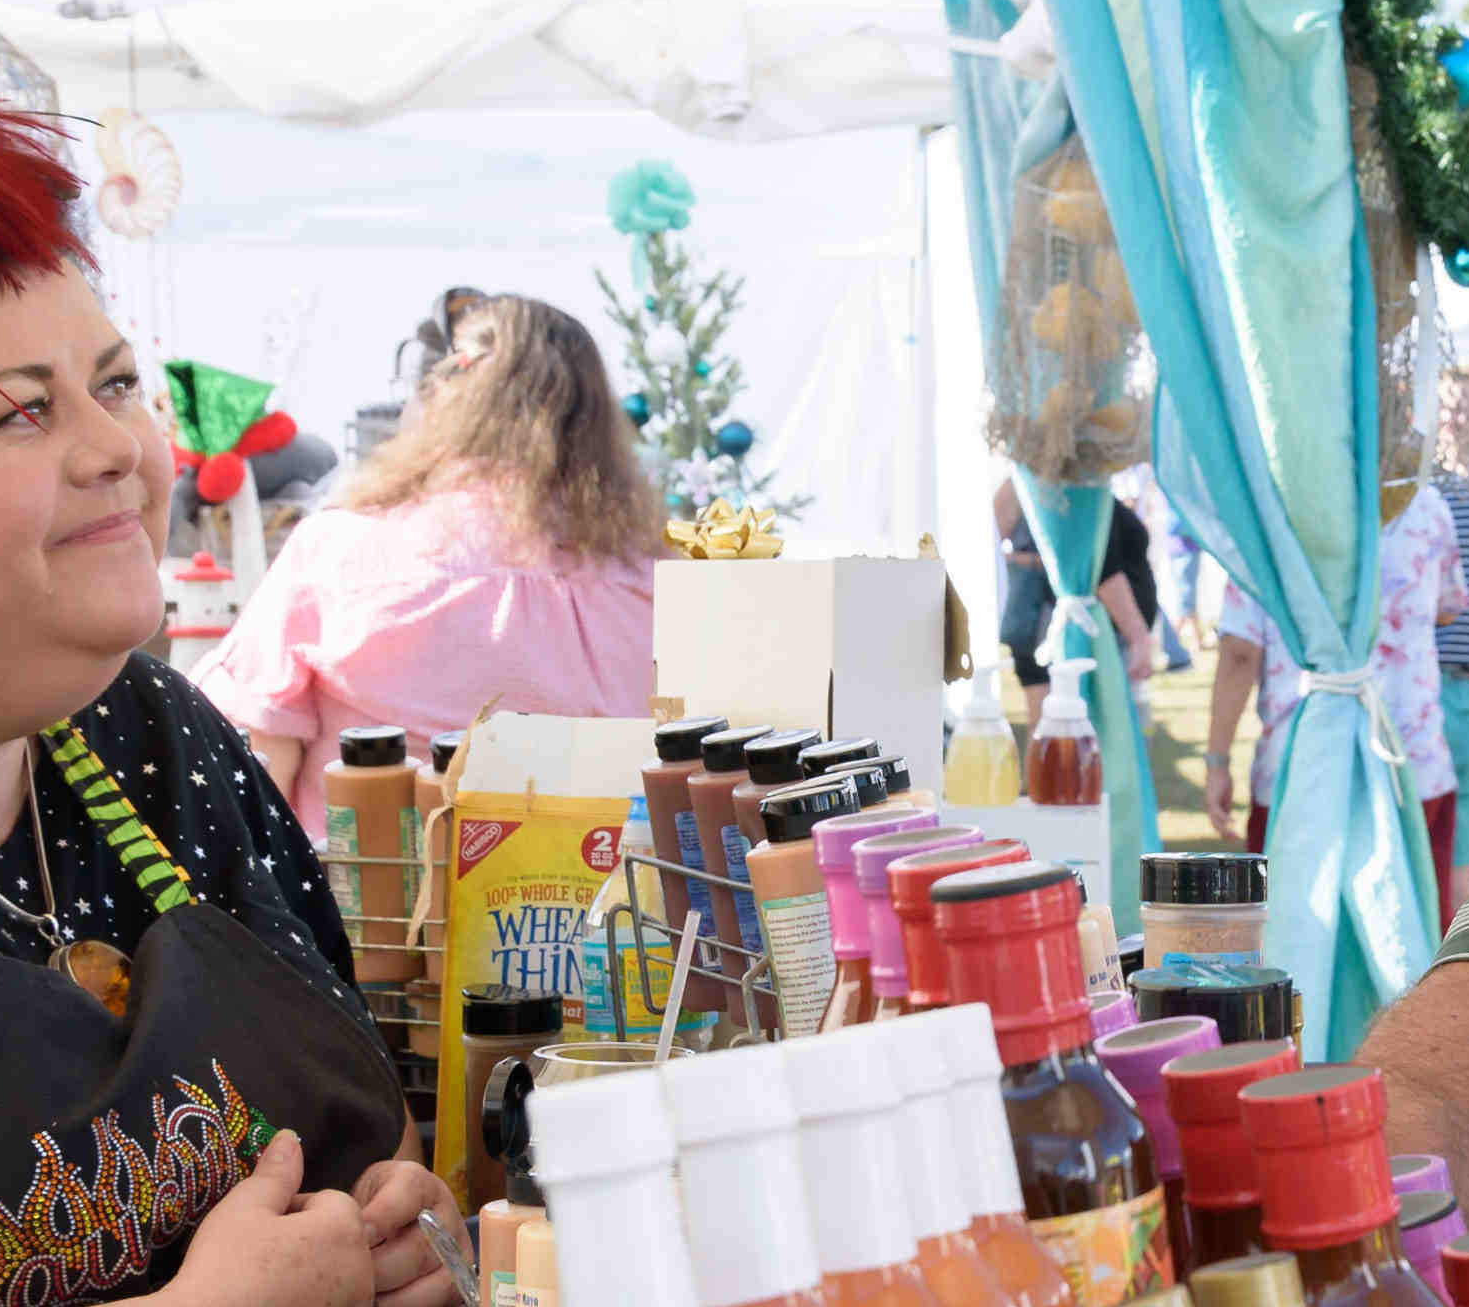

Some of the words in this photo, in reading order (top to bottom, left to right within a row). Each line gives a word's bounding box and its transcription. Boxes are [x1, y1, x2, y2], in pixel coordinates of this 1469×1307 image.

[591, 830, 613, 852] 2
[519, 884, 570, 902] WHOLE
[487, 904, 587, 948] WHEA
